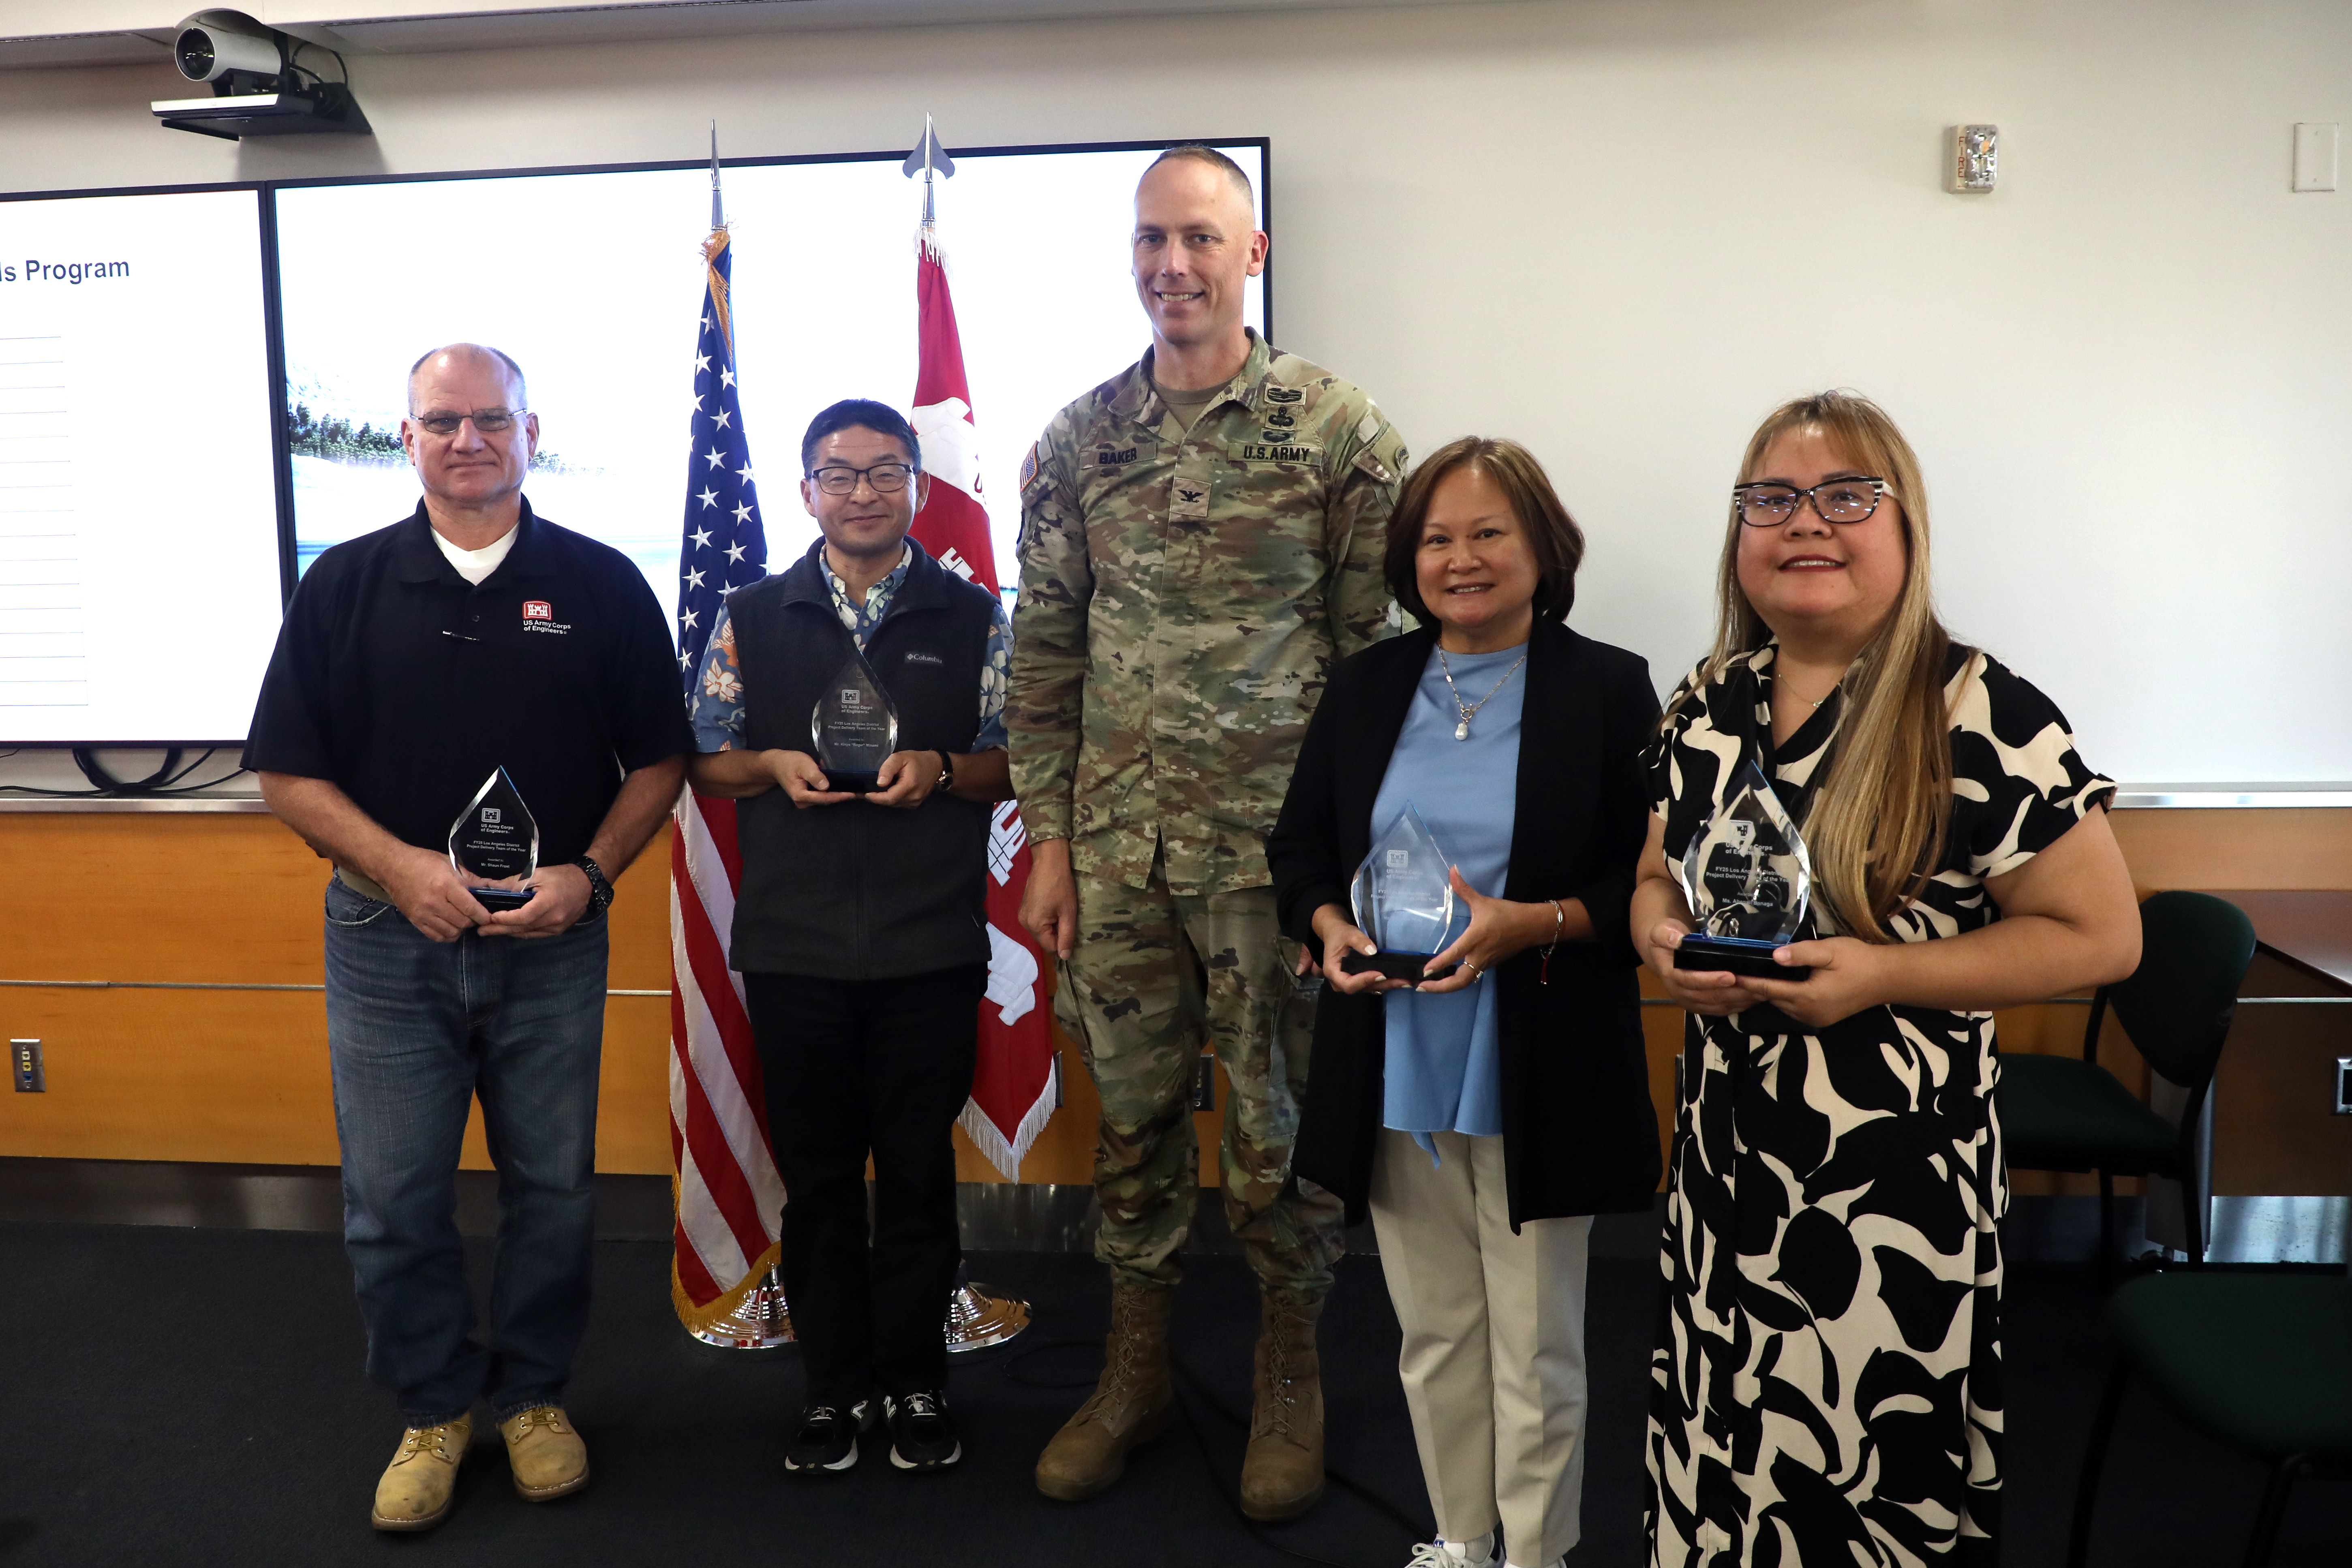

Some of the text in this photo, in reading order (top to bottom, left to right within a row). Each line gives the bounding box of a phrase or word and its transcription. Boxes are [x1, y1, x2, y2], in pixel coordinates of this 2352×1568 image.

[26, 260, 129, 285] Program
[1099, 447, 1137, 464] BAKER
[534, 620, 552, 628] Army
[914, 654, 942, 663] Columbia
